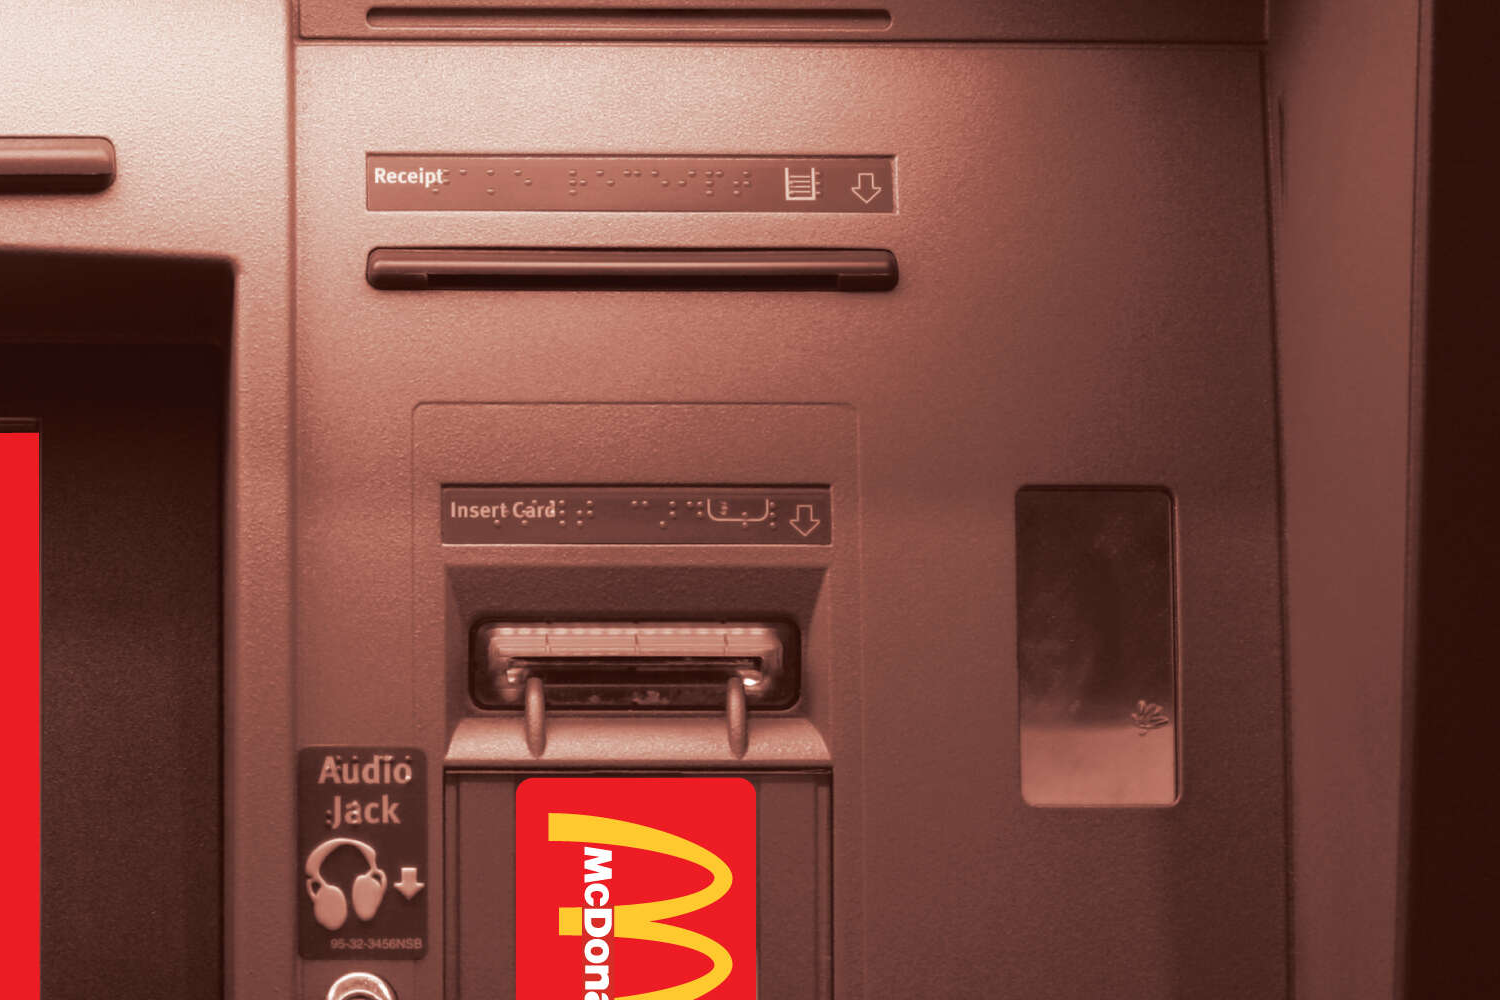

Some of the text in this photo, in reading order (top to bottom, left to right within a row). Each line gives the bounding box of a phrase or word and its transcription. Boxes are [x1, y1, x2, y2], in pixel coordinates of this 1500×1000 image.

[374, 167, 444, 188] Receipt
[450, 501, 555, 519] Insert Card
[318, 756, 413, 785] Audio
[331, 796, 401, 829] Jack
